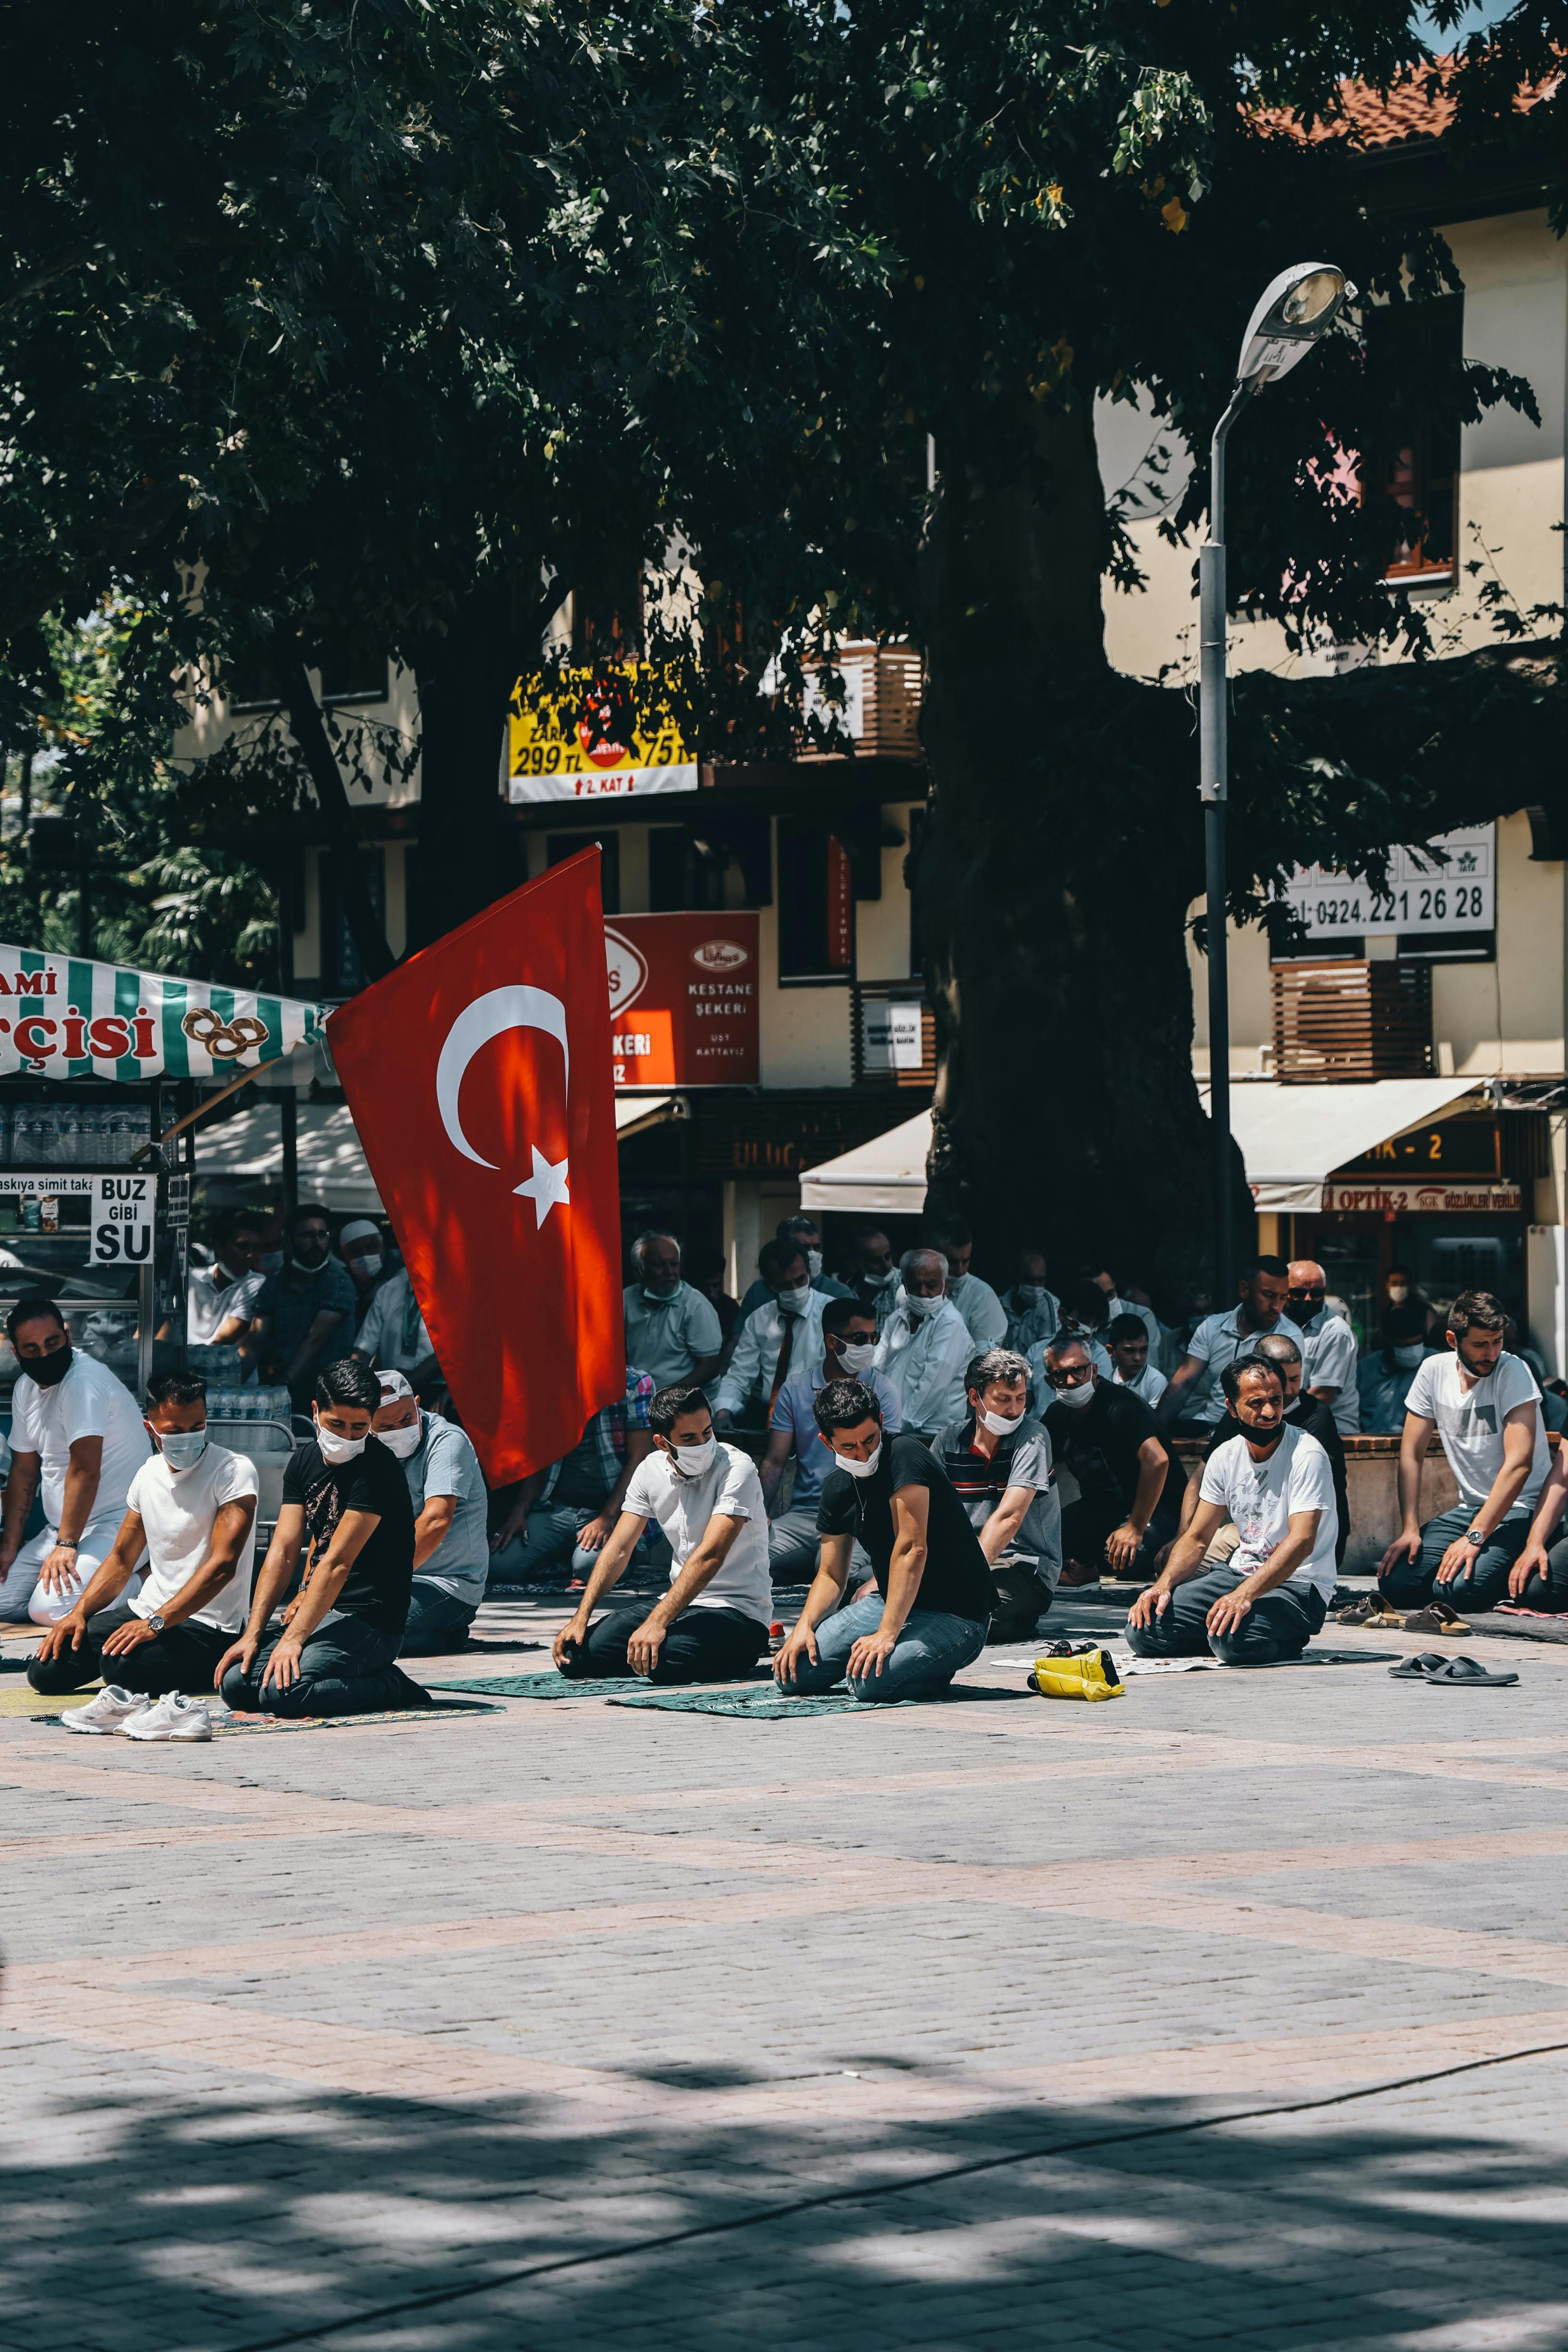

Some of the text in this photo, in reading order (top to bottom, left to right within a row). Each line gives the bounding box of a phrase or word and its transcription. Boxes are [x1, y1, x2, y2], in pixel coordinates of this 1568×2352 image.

[514, 746, 583, 776] 299 TL
[644, 733, 674, 766] 75
[600, 777, 623, 792] KAT
[1420, 887, 1446, 920] 26
[1456, 885, 1483, 918] 28
[688, 984, 753, 995] KESTANE
[1429, 1134, 1442, 1160] 2
[0, 1178, 35, 1193] askıya
[38, 1178, 67, 1190] simit
[102, 1179, 146, 1200] BUZ
[1339, 1186, 1409, 1210] OPTİK-2
[109, 1203, 137, 1220] GİBİ
[96, 1224, 150, 1261] SU
